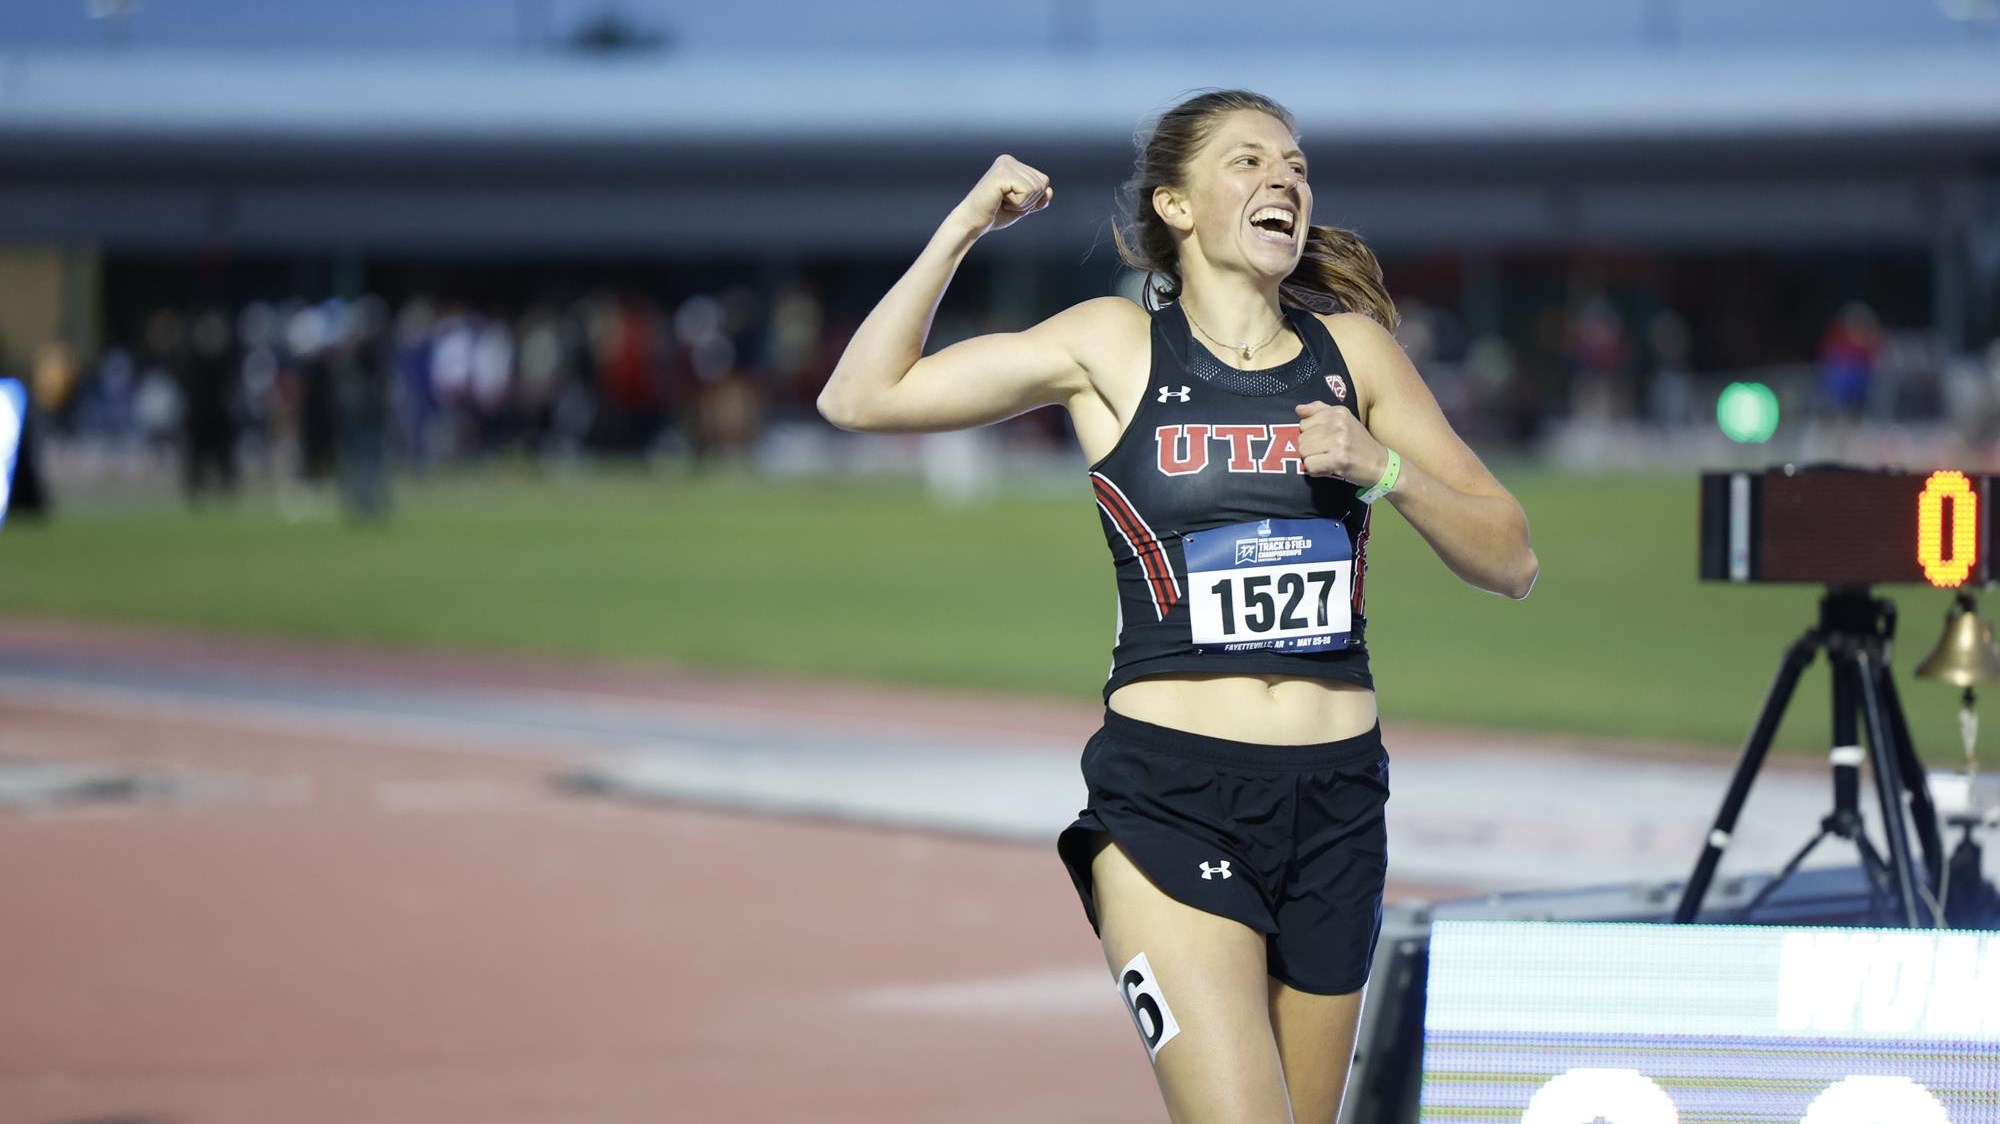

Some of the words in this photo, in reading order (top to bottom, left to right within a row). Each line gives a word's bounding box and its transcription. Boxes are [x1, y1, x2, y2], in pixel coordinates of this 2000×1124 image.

[1155, 423, 1308, 477] UTA
[1258, 541, 1284, 552] TRACK
[1291, 539, 1312, 549] FIELD
[1918, 470, 1976, 588] 0
[1211, 570, 1336, 635] 1527
[1273, 640, 1285, 649] AR
[1296, 637, 1312, 647] MAY
[1123, 969, 1165, 1050] 6
